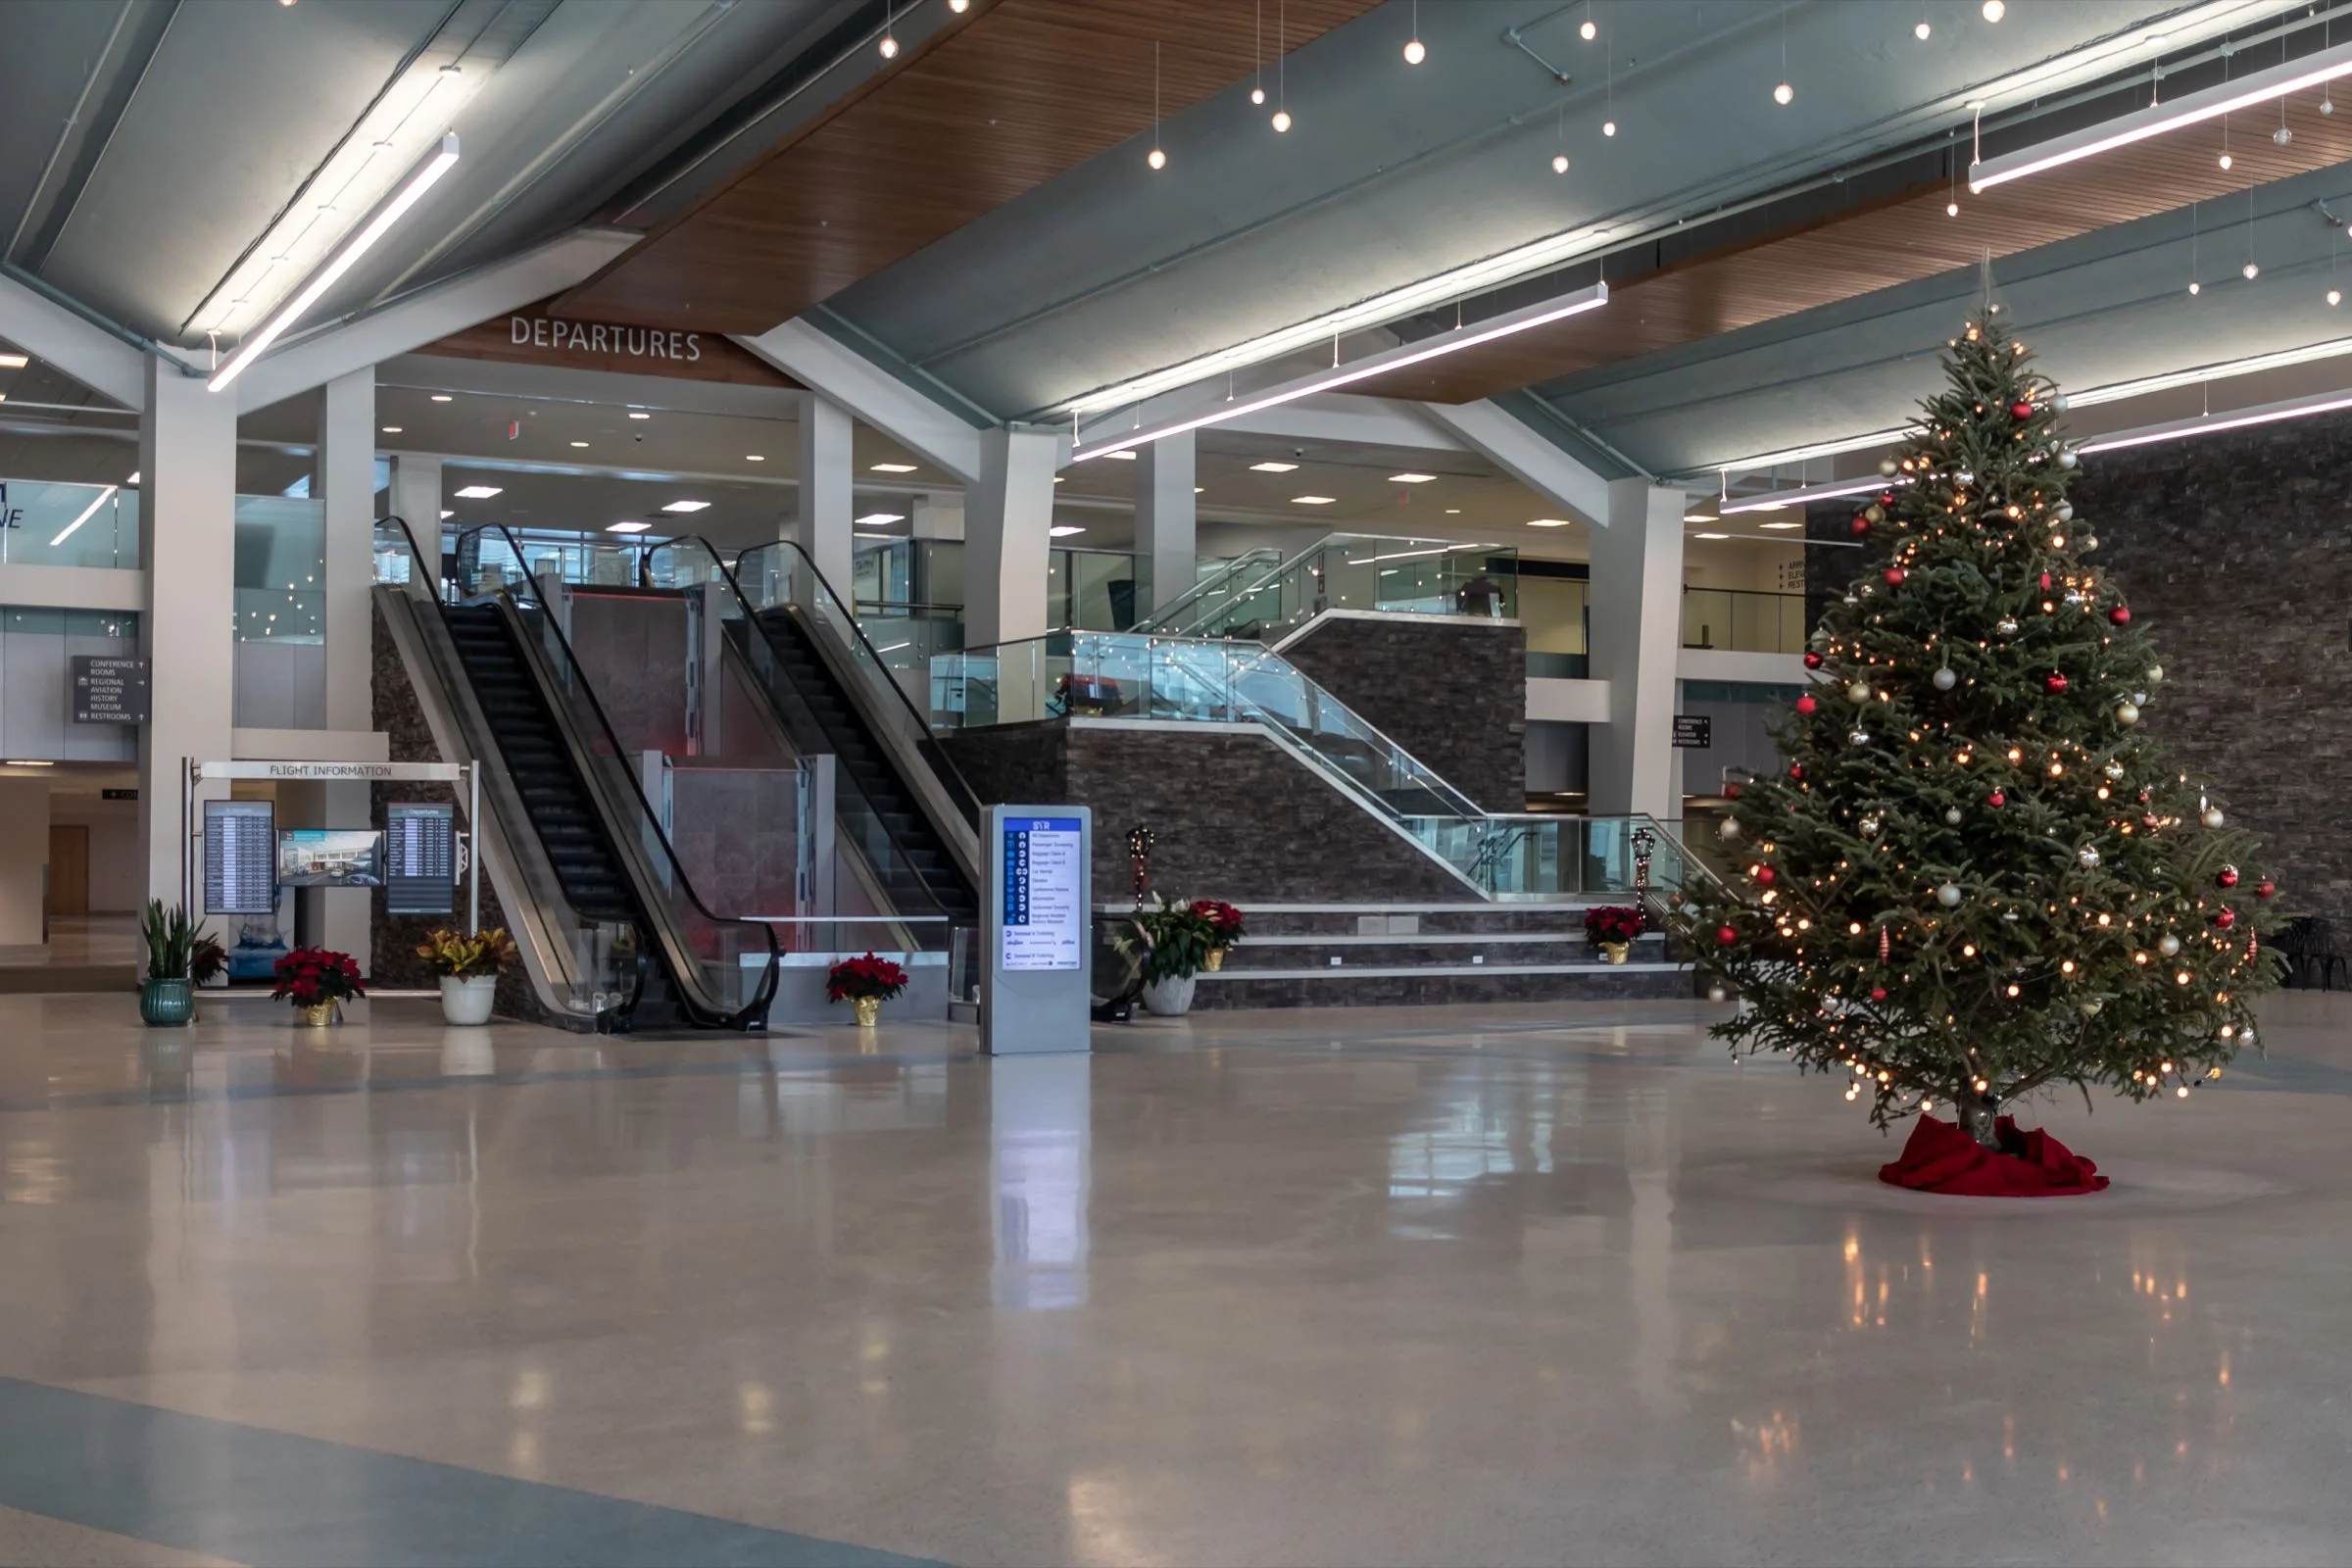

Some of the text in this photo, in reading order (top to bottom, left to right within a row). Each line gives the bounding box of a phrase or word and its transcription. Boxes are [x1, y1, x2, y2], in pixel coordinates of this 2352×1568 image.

[511, 317, 701, 362] DEPARTURES
[90, 660, 134, 668] CONFERENCE
[270, 765, 392, 777] FLIGHT INFORMATION
